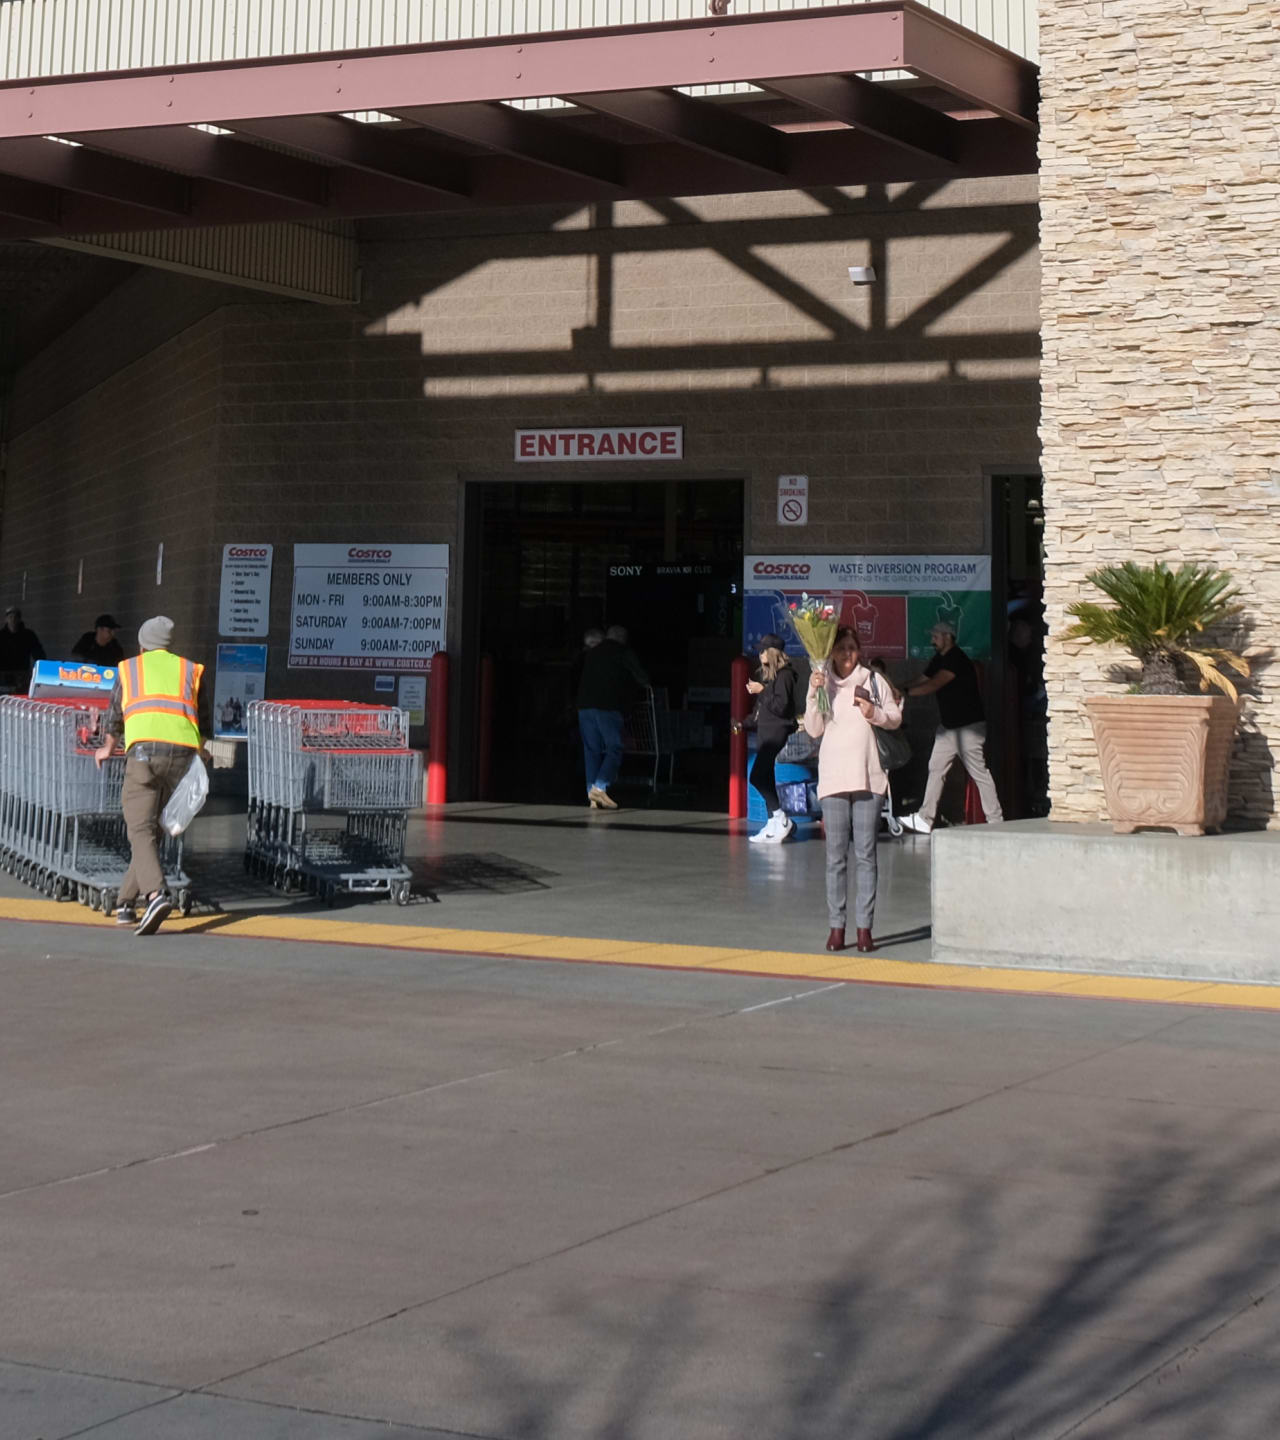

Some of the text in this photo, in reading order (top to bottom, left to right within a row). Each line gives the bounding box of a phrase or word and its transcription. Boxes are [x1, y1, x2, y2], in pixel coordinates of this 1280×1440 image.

[520, 431, 677, 457] ENTRANCE
[228, 547, 267, 557] COSTCO
[348, 547, 392, 558] COSTCO
[609, 566, 643, 576] SONY
[753, 561, 812, 574] COSTCO
[829, 563, 977, 574] WASTE DIVERSION PROGRAM
[327, 572, 412, 586] MEMBERS ONLY
[297, 594, 320, 606] MON
[328, 594, 345, 606] FRI
[363, 594, 442, 608] 9:00AM-8:30PM
[296, 615, 441, 630] SATURDAY 9:00AM-7:00PM
[295, 637, 335, 650] SUNDAY
[290, 656, 308, 665] OPEN
[349, 657, 363, 667] DAY
